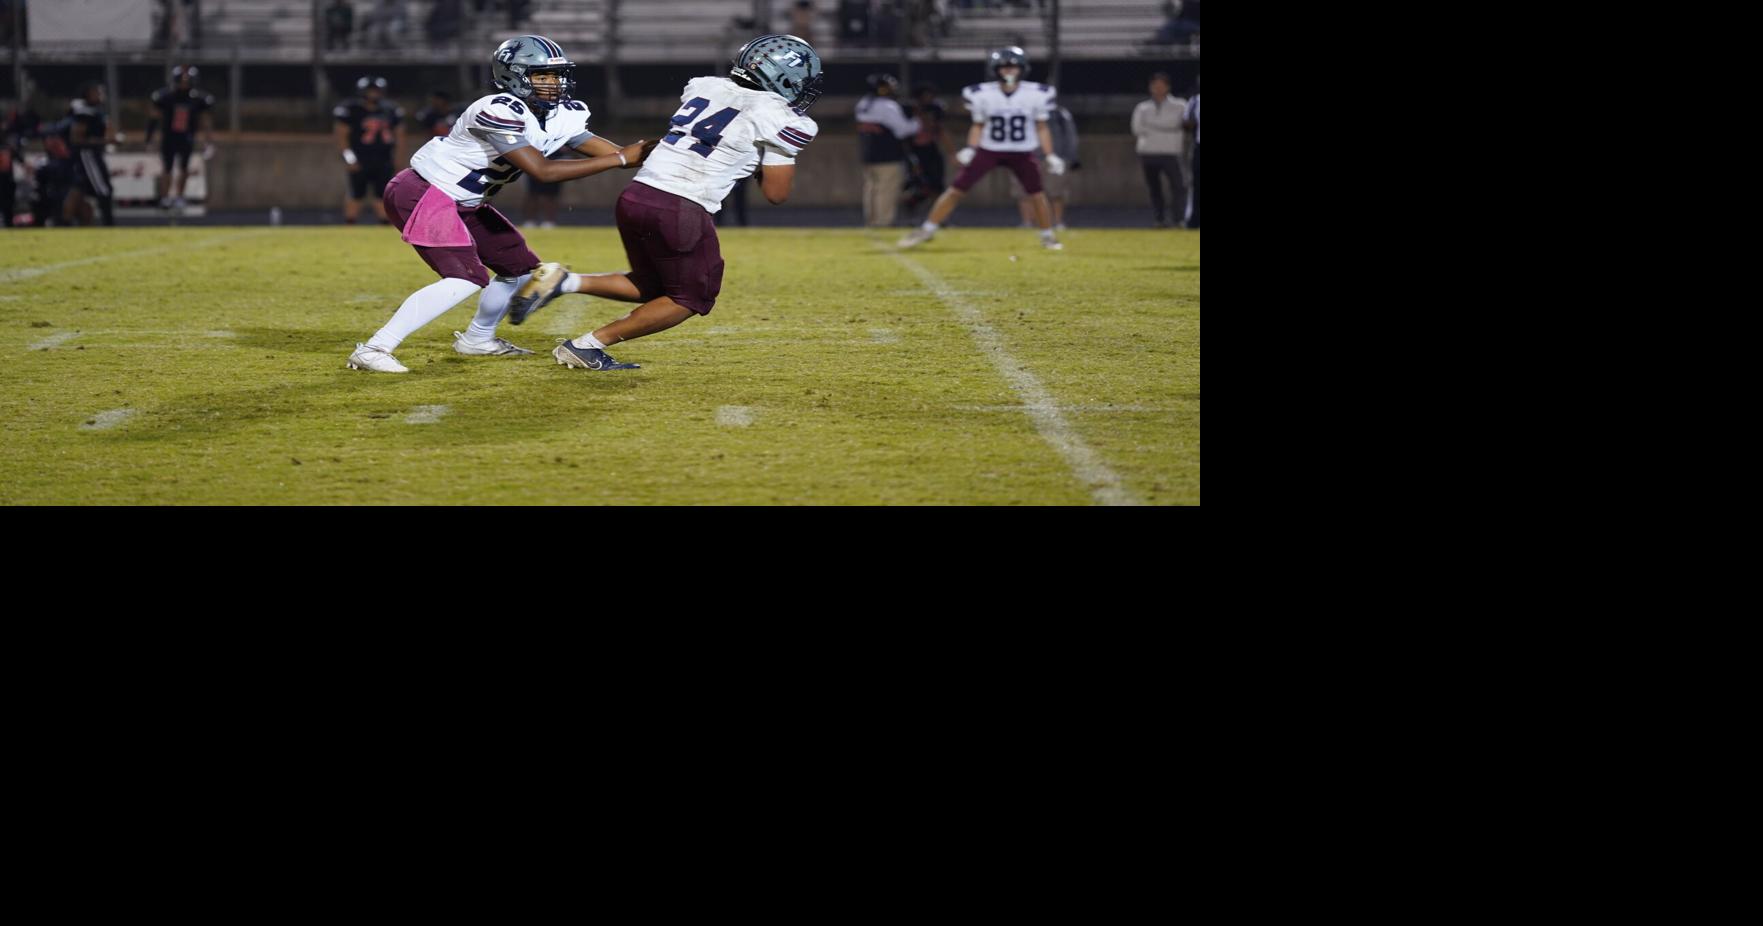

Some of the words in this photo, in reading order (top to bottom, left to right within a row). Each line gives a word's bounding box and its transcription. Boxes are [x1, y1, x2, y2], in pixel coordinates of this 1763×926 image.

[491, 96, 525, 115] 25
[662, 96, 741, 158] 24
[990, 115, 1026, 142] 88
